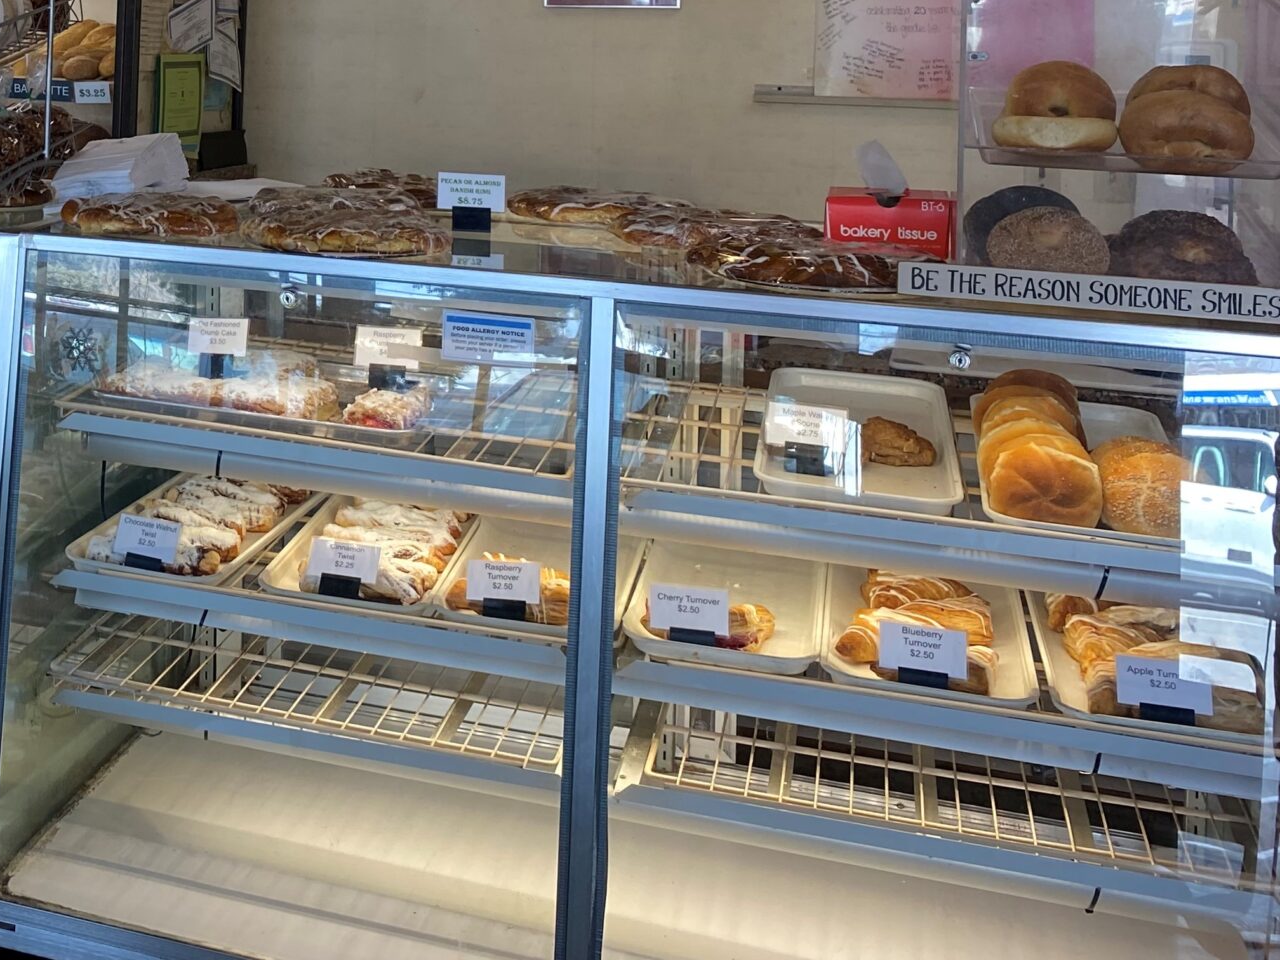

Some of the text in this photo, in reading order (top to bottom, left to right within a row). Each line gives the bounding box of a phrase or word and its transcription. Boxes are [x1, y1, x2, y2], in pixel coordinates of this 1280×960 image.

[14, 83, 106, 98] BATTE $3.25
[441, 177, 462, 185] PECAN
[474, 179, 501, 187] ALMOND
[921, 202, 944, 212] BT-6
[840, 224, 937, 241] bakery tissue
[911, 266, 939, 292] BE
[948, 269, 987, 295] THE
[994, 273, 1081, 303] REASON
[1088, 280, 1192, 312] SOMEONE
[471, 327, 500, 335] ALLERGY
[501, 329, 526, 337] NOTICE
[124, 516, 155, 529] Chocolate
[485, 563, 522, 573] Raspberry
[488, 573, 519, 581] Turnover
[657, 592, 720, 606] Cherry Turnover
[677, 605, 700, 614] $2.50
[901, 626, 943, 640] Blueberry
[903, 637, 942, 650] Turnover
[910, 648, 935, 660] $2.50
[1127, 664, 1179, 679] Apple Turn
[1150, 678, 1177, 691] $2.50
